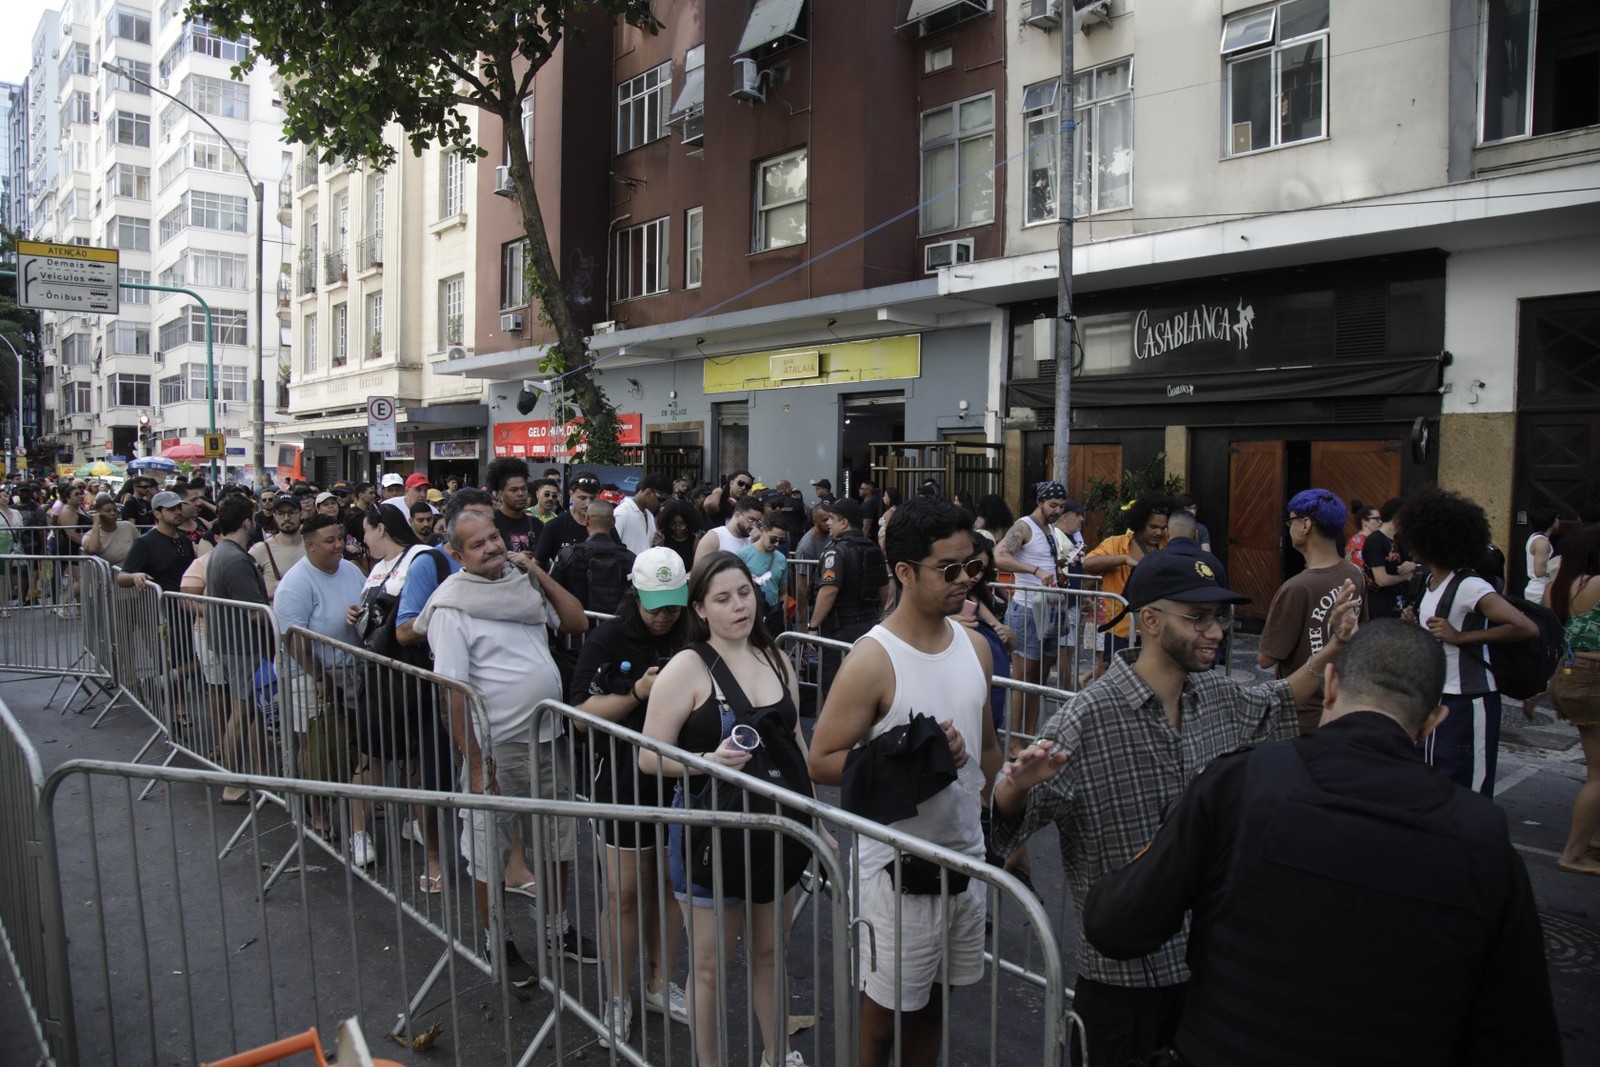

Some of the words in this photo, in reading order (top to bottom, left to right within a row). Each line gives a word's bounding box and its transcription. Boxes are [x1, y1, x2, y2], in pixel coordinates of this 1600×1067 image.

[48, 247, 88, 258] ATENÇÃO
[47, 259, 85, 269] Demais
[46, 290, 83, 302] Ônibus
[377, 403, 386, 416] E
[528, 427, 547, 437] GELO
